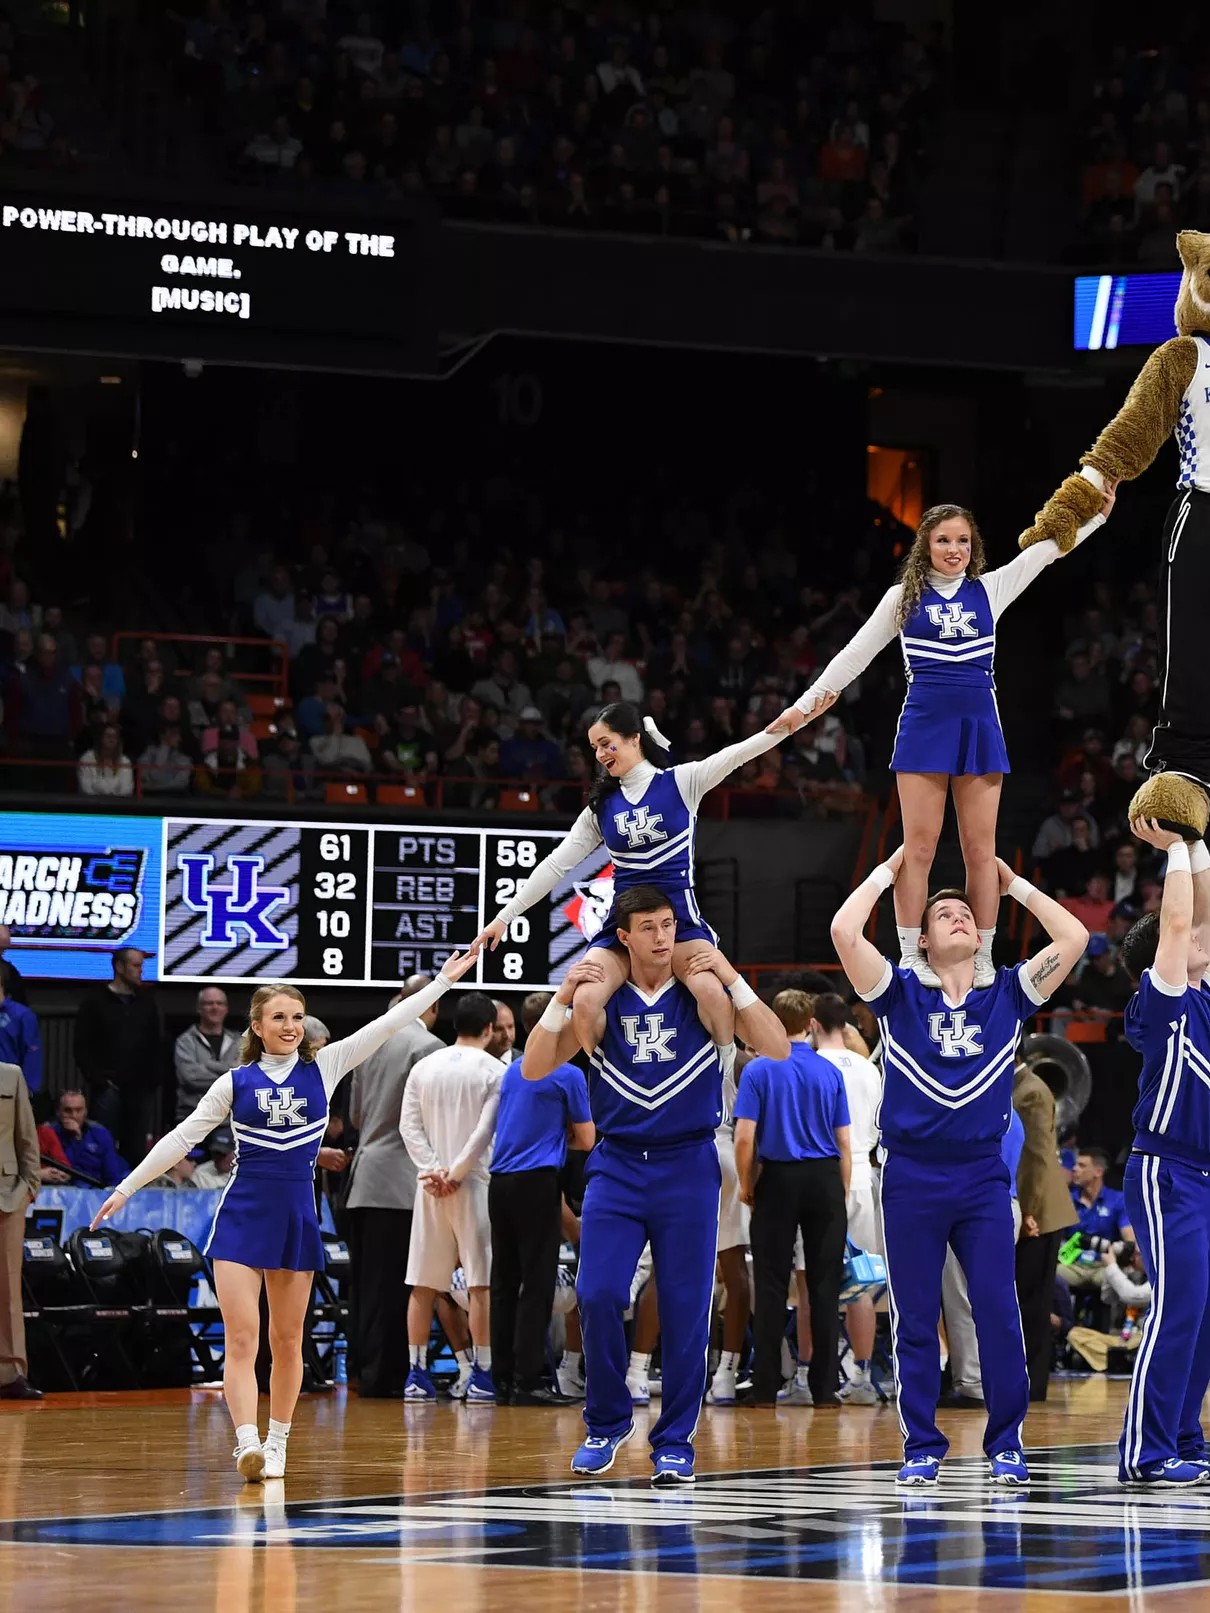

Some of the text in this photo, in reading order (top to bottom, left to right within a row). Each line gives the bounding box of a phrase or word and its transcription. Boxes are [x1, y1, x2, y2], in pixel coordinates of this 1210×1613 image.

[2, 205, 395, 257] POWER-THROUGH PLAY OF THE
[160, 254, 242, 280] GAME.
[151, 286, 250, 319] [MUSIC]
[925, 602, 979, 639] UK
[613, 805, 668, 849] UK
[319, 833, 537, 867] 61 PTS 58
[177, 853, 291, 950] UK
[313, 871, 357, 900] 32
[396, 875, 455, 902] REB
[0, 890, 136, 928] ADNESS
[316, 910, 351, 938] 10
[395, 910, 453, 940] AST
[322, 947, 344, 976] 8
[502, 952, 524, 980] 8
[621, 1012, 677, 1064] UK
[928, 1010, 984, 1058] UK
[254, 1086, 308, 1127] UK
